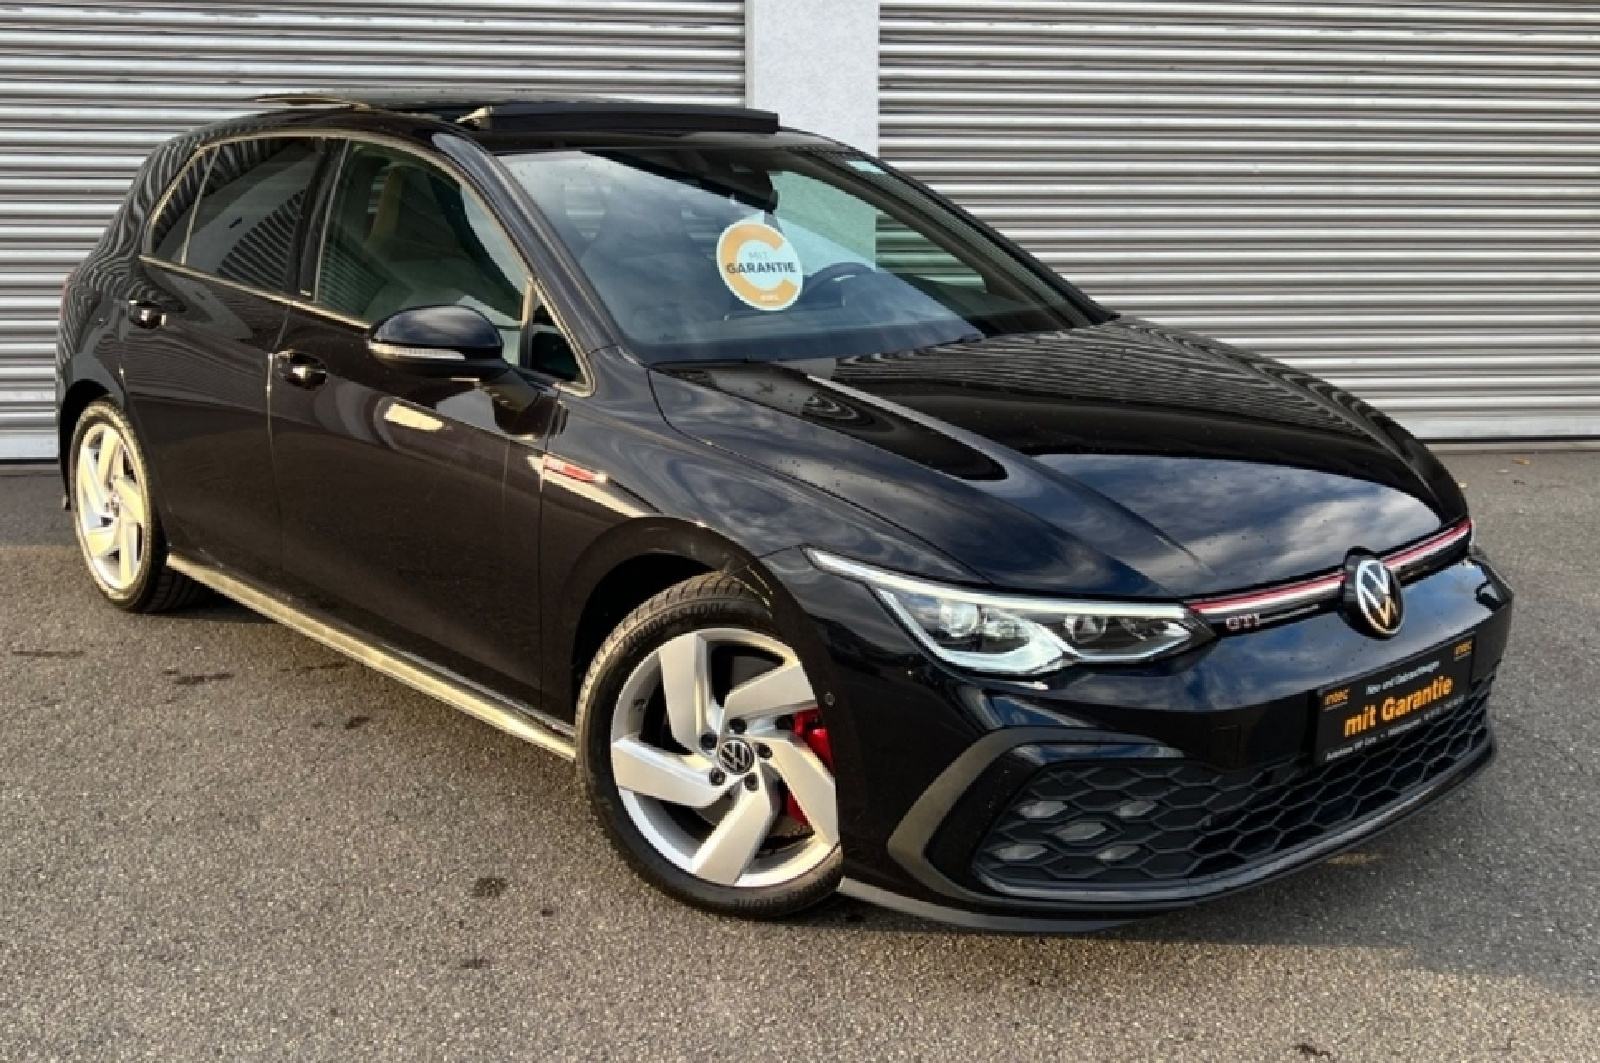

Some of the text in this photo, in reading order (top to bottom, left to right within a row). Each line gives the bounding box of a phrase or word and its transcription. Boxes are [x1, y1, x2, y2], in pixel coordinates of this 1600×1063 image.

[726, 262, 797, 273] GARANTIE
[1225, 612, 1261, 631] GTI
[1344, 704, 1377, 737] mit
[1381, 675, 1455, 721] Garantie
